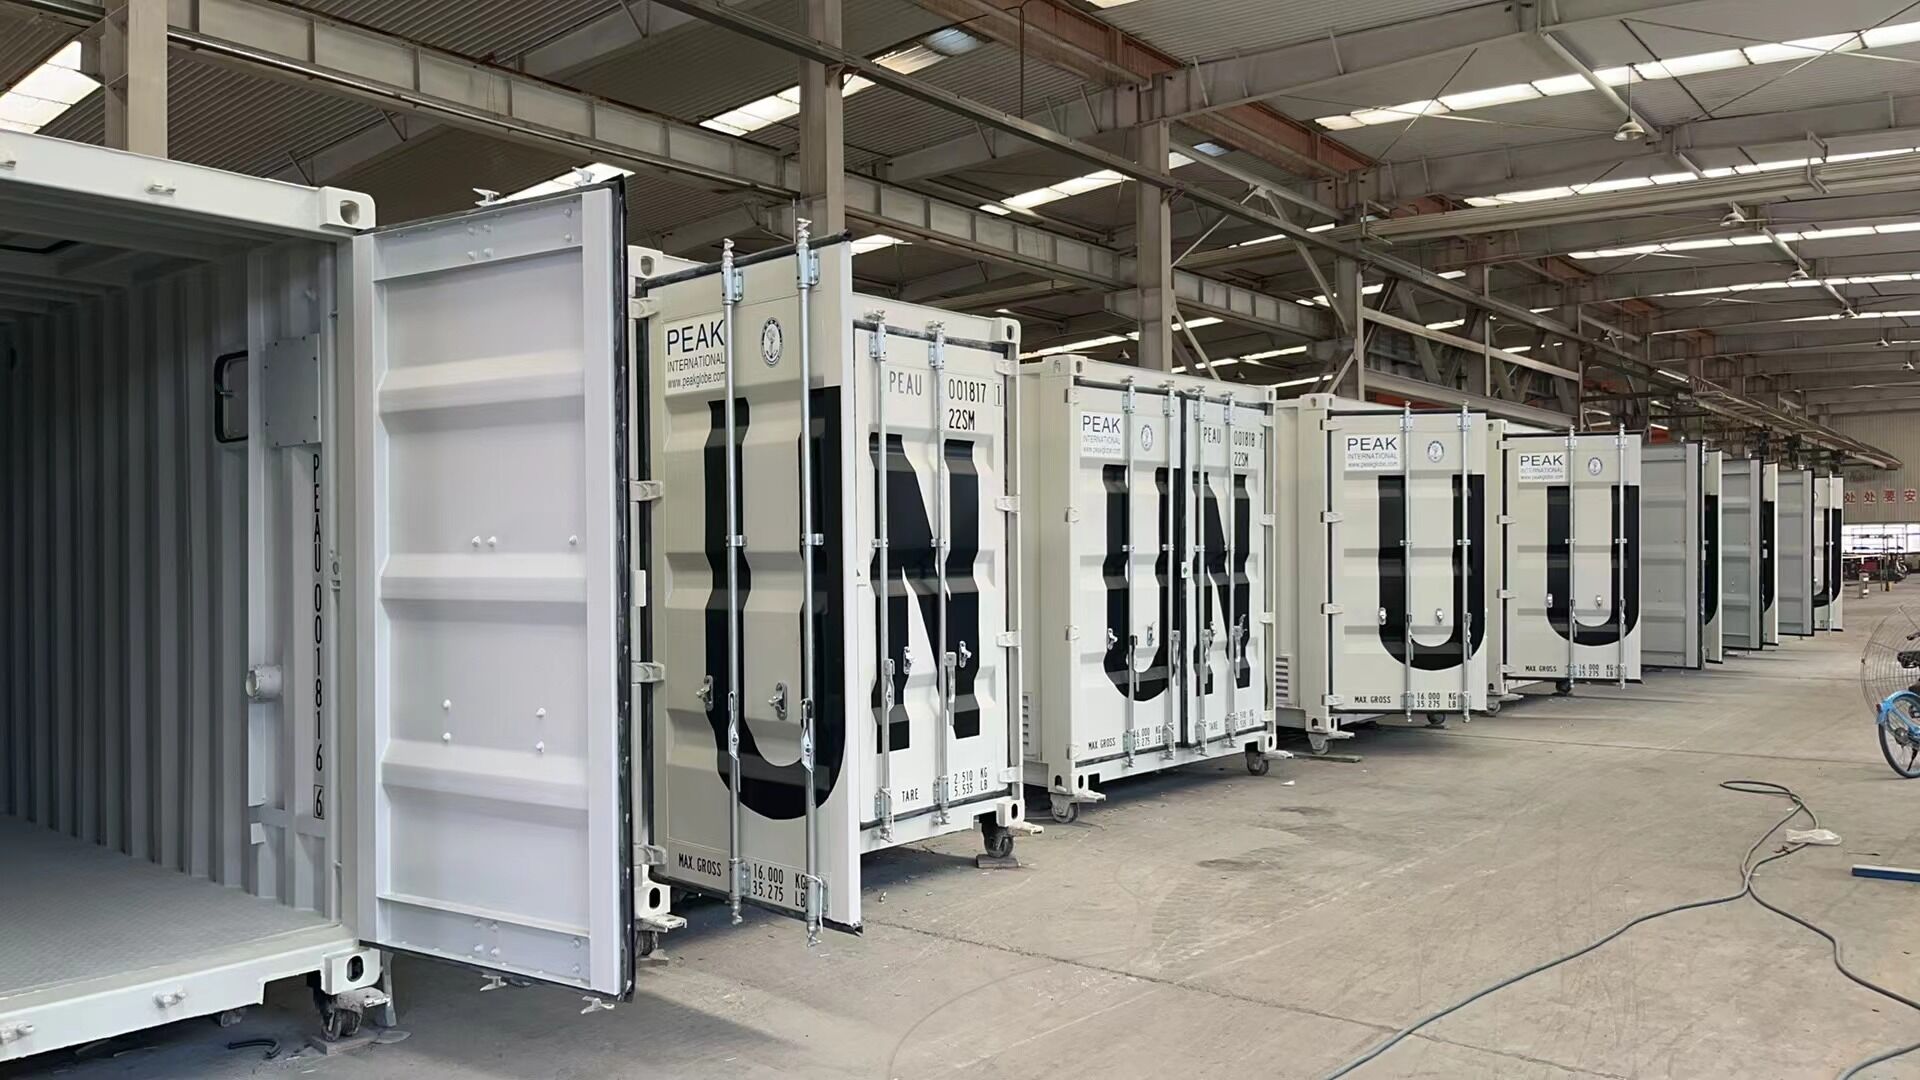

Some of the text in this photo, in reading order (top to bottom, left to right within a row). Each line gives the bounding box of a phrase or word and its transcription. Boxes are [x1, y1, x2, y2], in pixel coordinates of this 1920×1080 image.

[667, 320, 725, 356] PEAK
[667, 352, 726, 373] INTERNATIONAL
[889, 371, 922, 396] PEAU
[948, 378, 987, 403] 001817
[948, 408, 975, 431] 22SM
[1082, 415, 1120, 434] PEAK
[1203, 426, 1221, 444] PEAU
[1347, 437, 1397, 451] PEAK
[1234, 451, 1248, 468] 22SM
[1520, 455, 1563, 466] PEAK
[313, 454, 323, 818] PEAU 001816 6
[1370, 696, 1391, 704] GROSS
[1448, 692, 1456, 700] KG
[902, 788, 919, 802] TARE
[697, 857, 722, 877] GROSS
[753, 863, 806, 890] 16.000 KG
[752, 880, 806, 908] 35.275 LB
